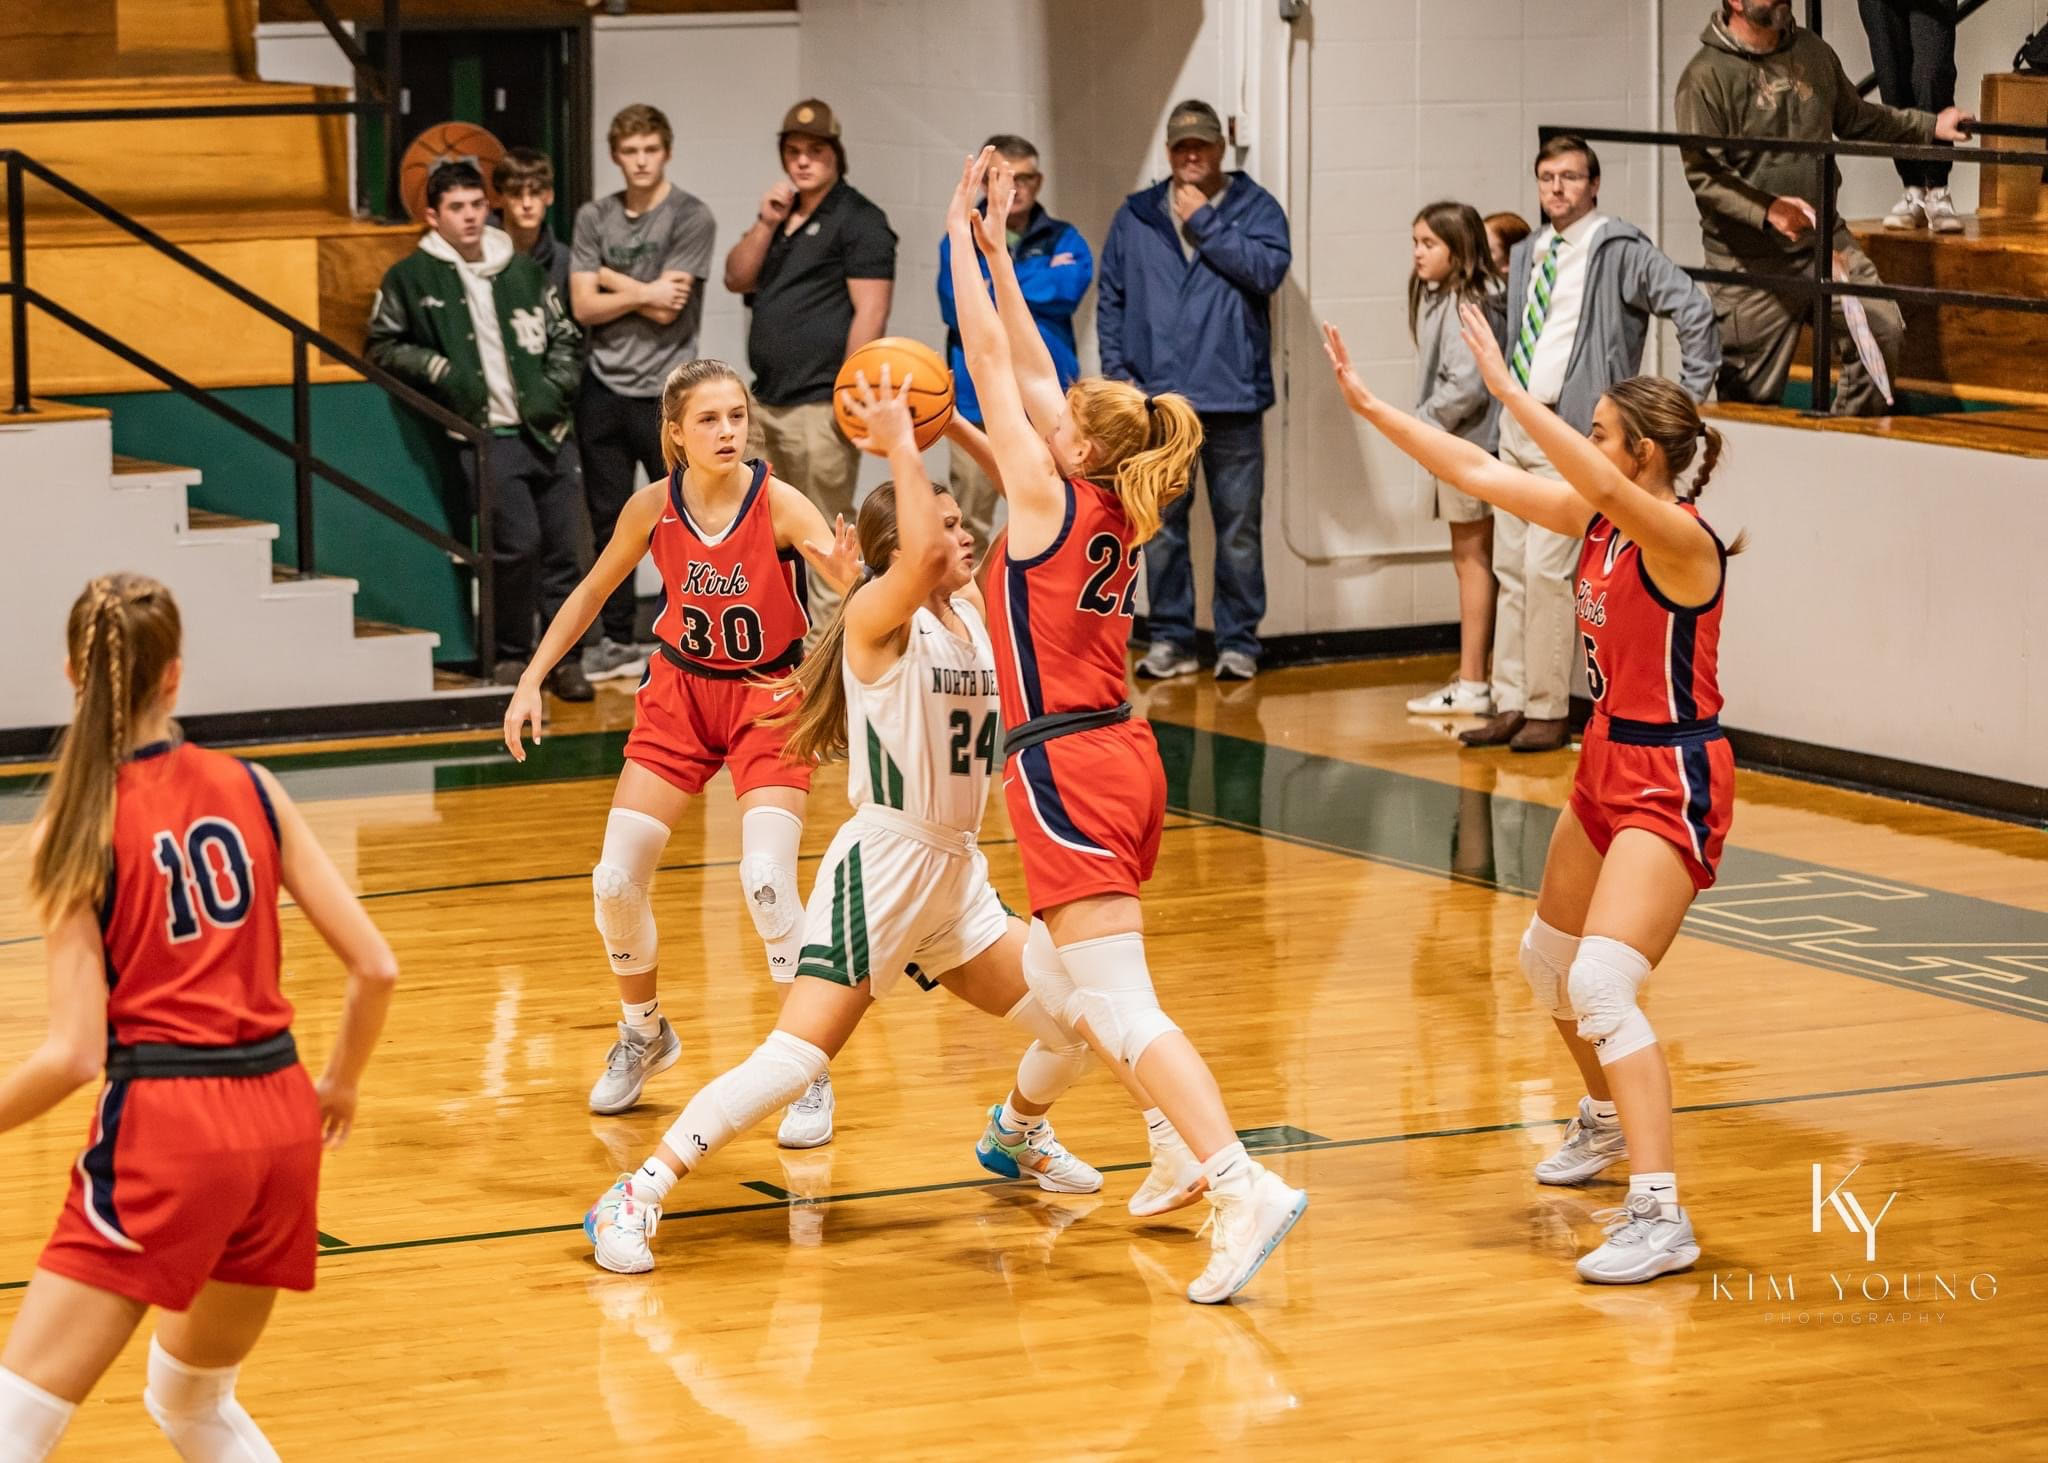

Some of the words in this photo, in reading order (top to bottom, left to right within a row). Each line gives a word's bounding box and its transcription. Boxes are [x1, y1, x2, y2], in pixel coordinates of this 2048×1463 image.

[681, 560, 749, 597] Kirk
[1076, 532, 1143, 619] 22
[679, 604, 765, 662] 30
[932, 667, 977, 696] NORTH
[949, 708, 999, 777] 24
[152, 816, 256, 945] 10
